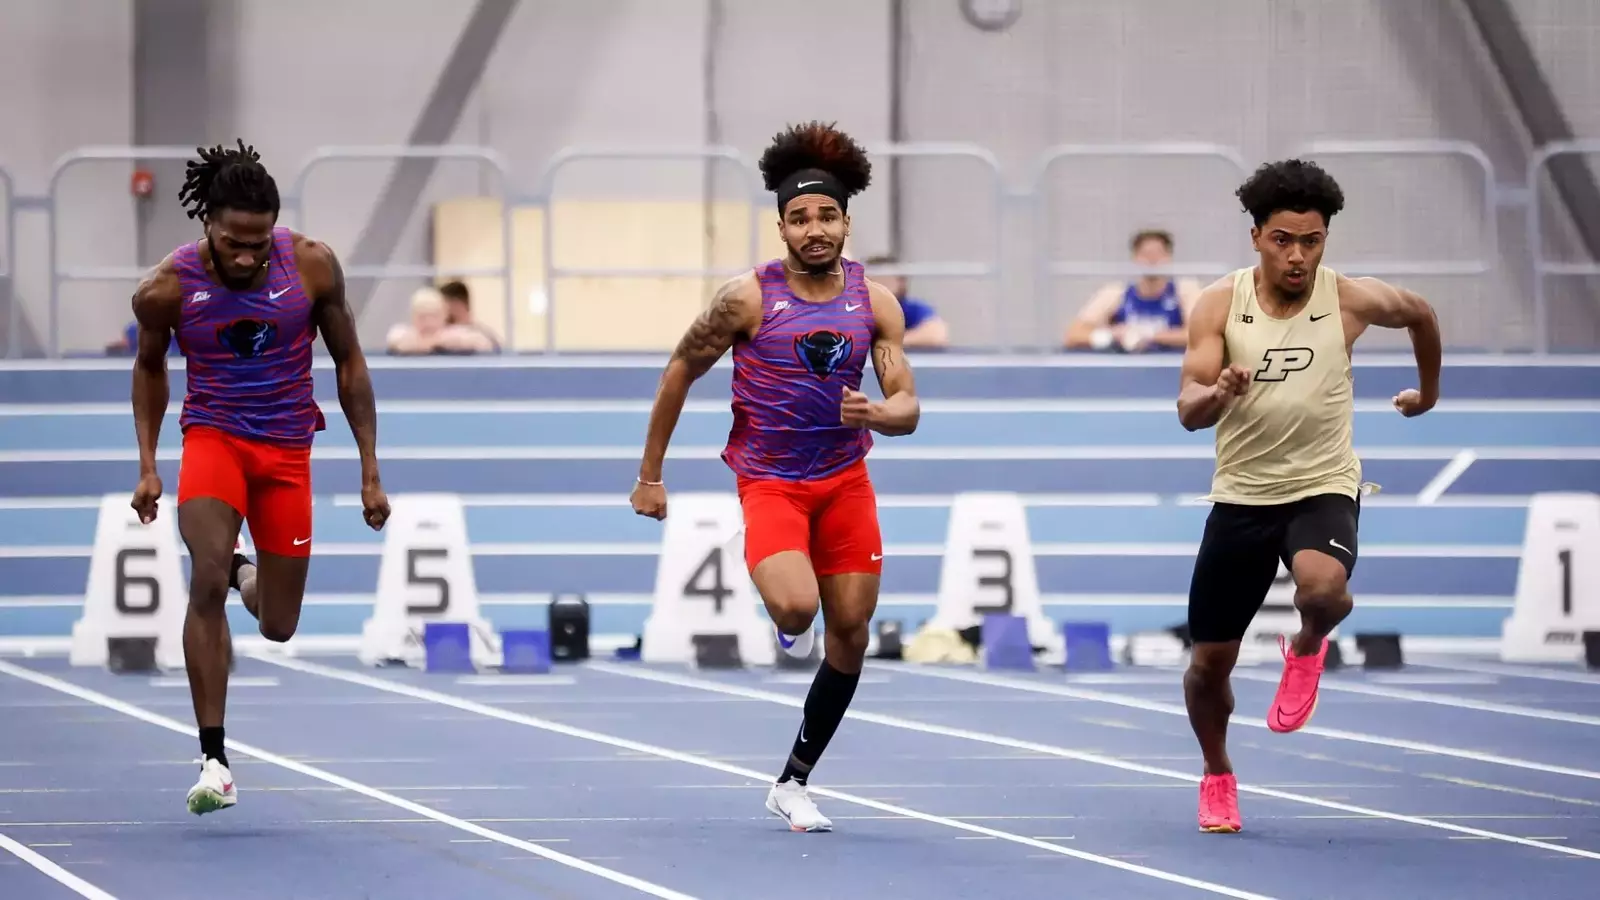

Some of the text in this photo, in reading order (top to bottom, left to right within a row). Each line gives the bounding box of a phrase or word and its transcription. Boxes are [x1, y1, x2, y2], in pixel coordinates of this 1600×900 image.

[1253, 347, 1315, 383] P
[114, 548, 161, 615] 6
[406, 548, 450, 615] 5
[683, 547, 734, 613] 4
[972, 549, 1014, 614] 3
[1557, 549, 1573, 615] 1
